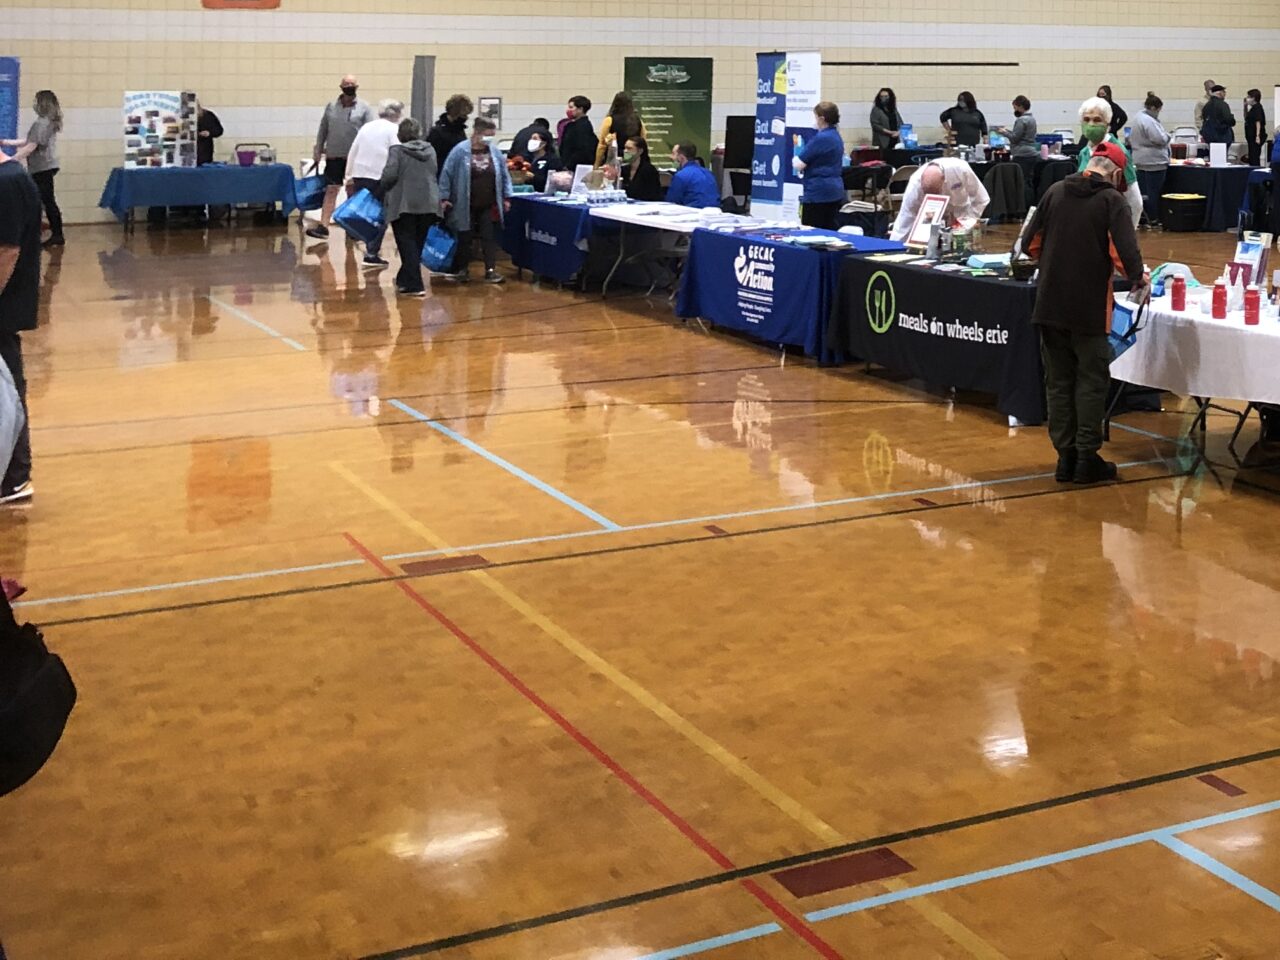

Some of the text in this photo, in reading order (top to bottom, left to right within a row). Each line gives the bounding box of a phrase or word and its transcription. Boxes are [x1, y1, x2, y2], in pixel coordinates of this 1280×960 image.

[758, 78, 771, 93] Got
[755, 119, 769, 134] Got
[752, 160, 766, 175] Get
[748, 245, 775, 262] GECAC
[742, 260, 774, 291] Action
[898, 312, 1009, 344] meals on wheels erie
